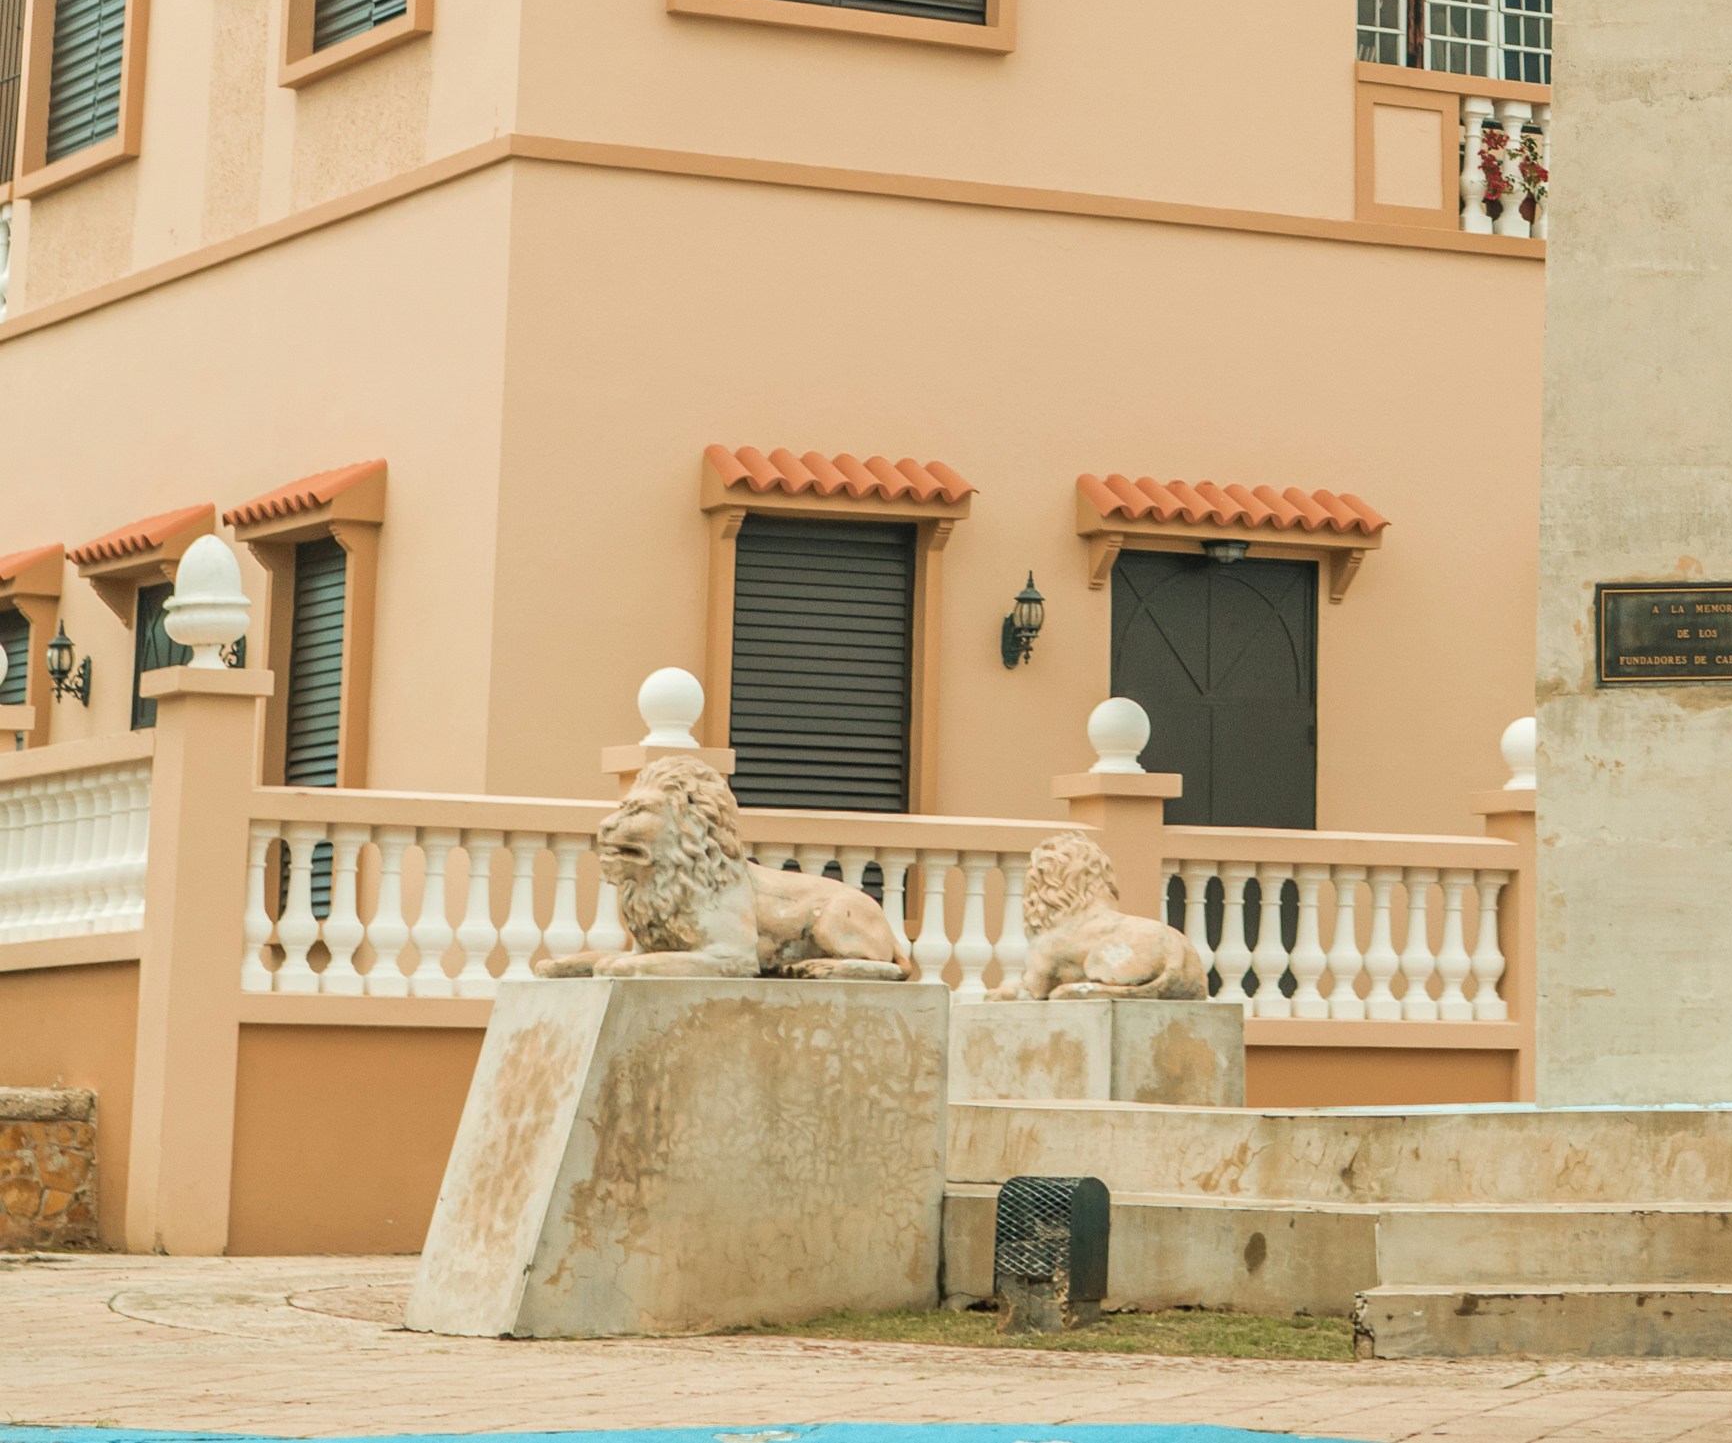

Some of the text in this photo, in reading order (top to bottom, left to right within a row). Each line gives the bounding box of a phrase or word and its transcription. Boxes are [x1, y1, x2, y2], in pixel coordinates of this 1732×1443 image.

[1652, 605, 1659, 614] A
[1671, 604, 1684, 614] LA
[1677, 629, 1718, 638] DE LOS
[1619, 655, 1687, 665] FUNDADORES
[1694, 655, 1707, 664] DE
